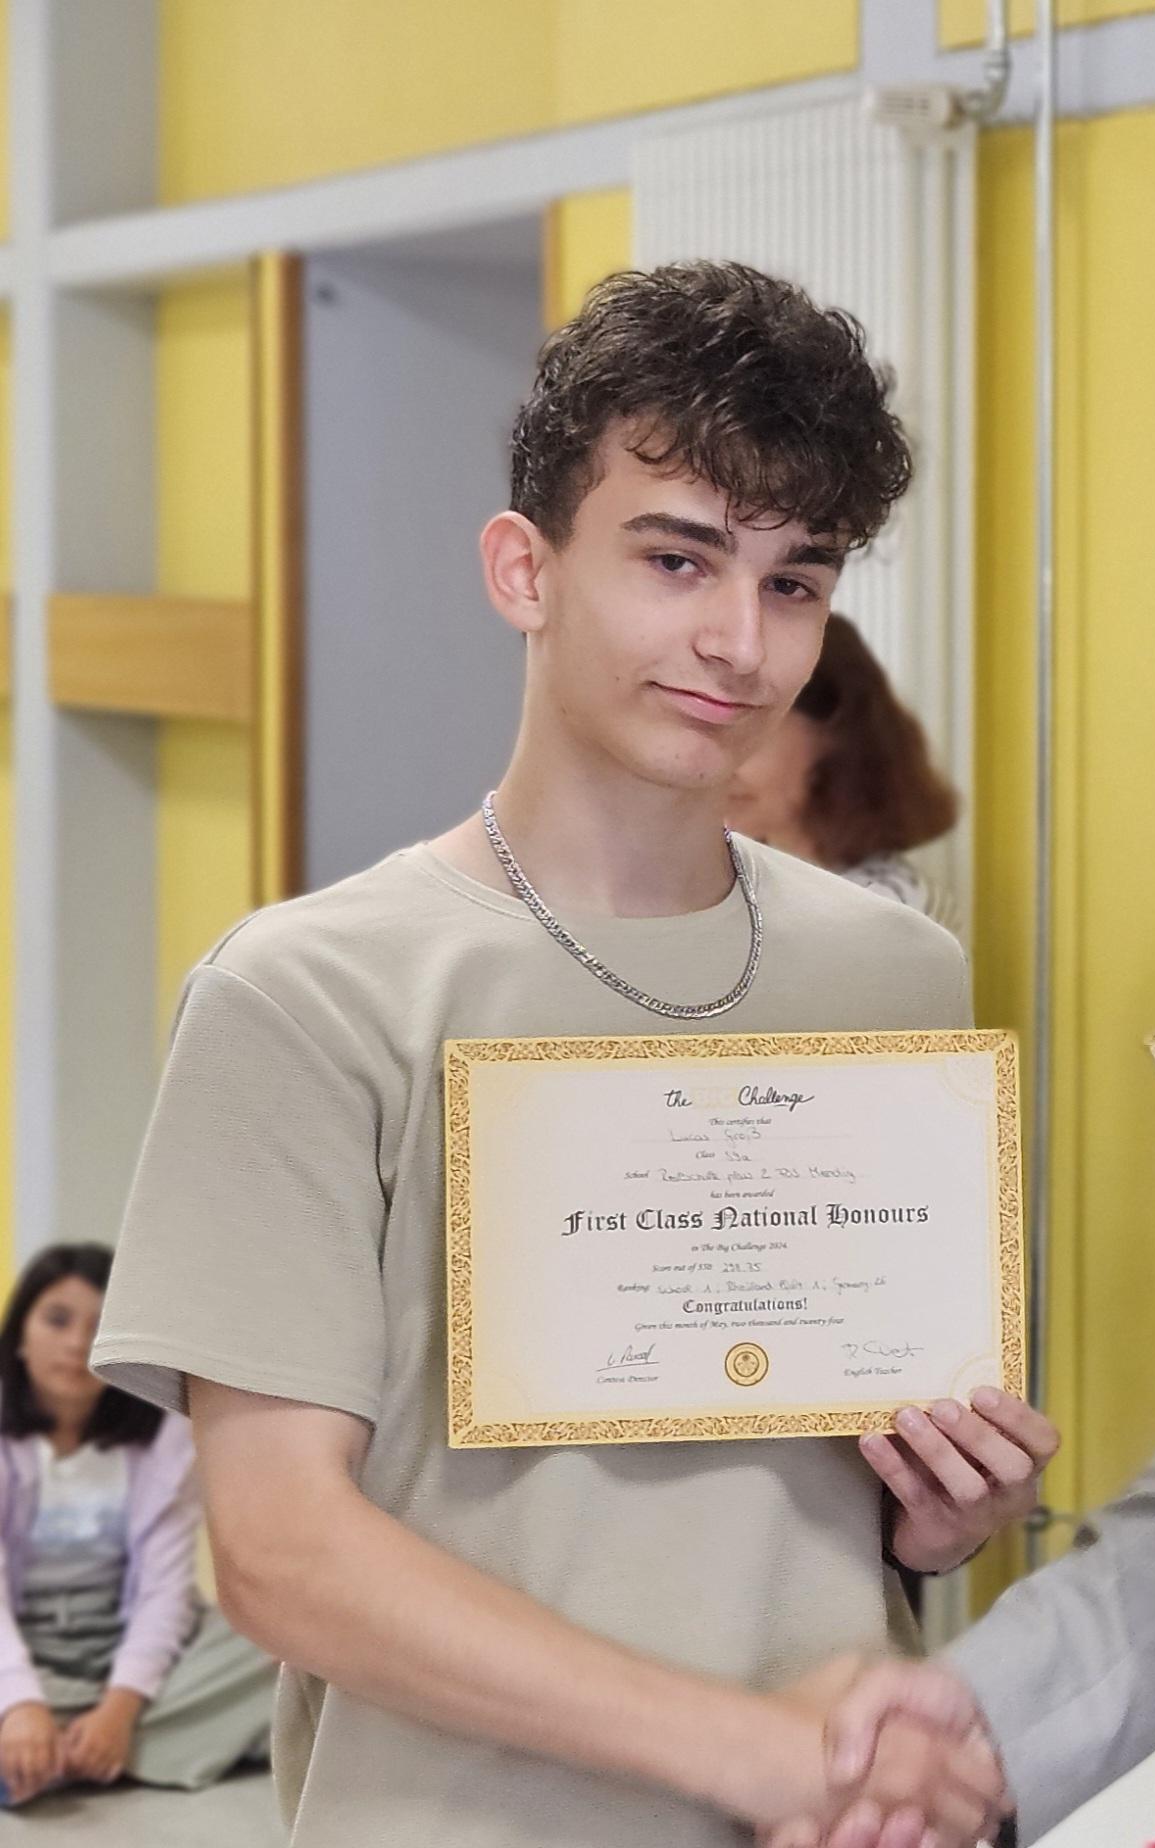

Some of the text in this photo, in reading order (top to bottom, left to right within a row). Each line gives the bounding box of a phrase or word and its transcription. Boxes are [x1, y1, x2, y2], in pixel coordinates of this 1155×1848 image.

[738, 1085, 815, 1112] Challenge
[710, 1188, 775, 1199] has been awarded
[561, 1203, 929, 1236] First Class National Honours
[682, 1297, 808, 1315] Congratulations!
[674, 1320, 698, 1329] month
[699, 1319, 709, 1331] of
[748, 1317, 782, 1327] thousand
[783, 1316, 799, 1326] and
